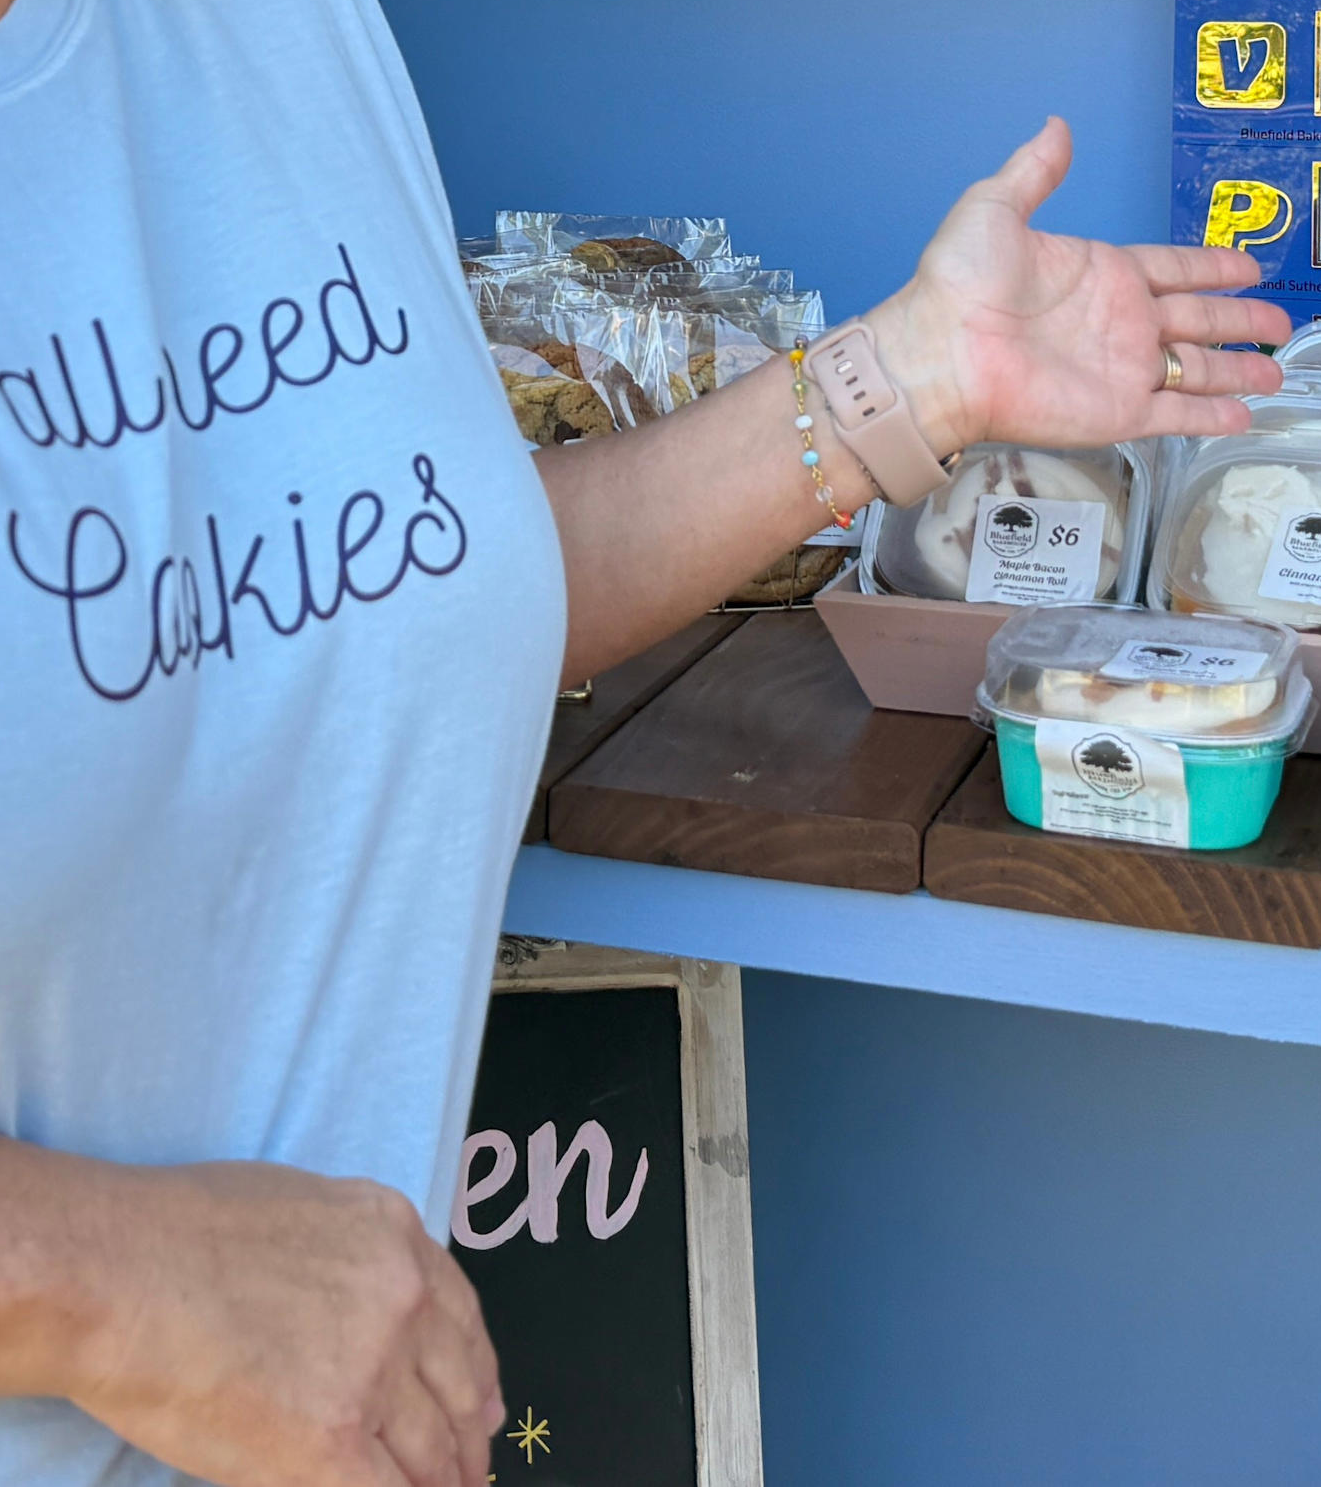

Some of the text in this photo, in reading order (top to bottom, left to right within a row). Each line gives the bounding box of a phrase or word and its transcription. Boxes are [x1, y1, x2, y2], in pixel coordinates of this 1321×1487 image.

[1240, 128, 1294, 142] Bluefield
[1248, 279, 1287, 291] randi
[1048, 524, 1080, 547] $6
[999, 559, 1066, 574] Maple Bacon
[993, 571, 1068, 587] Cinnamon Roll
[1200, 656, 1237, 666] $6
